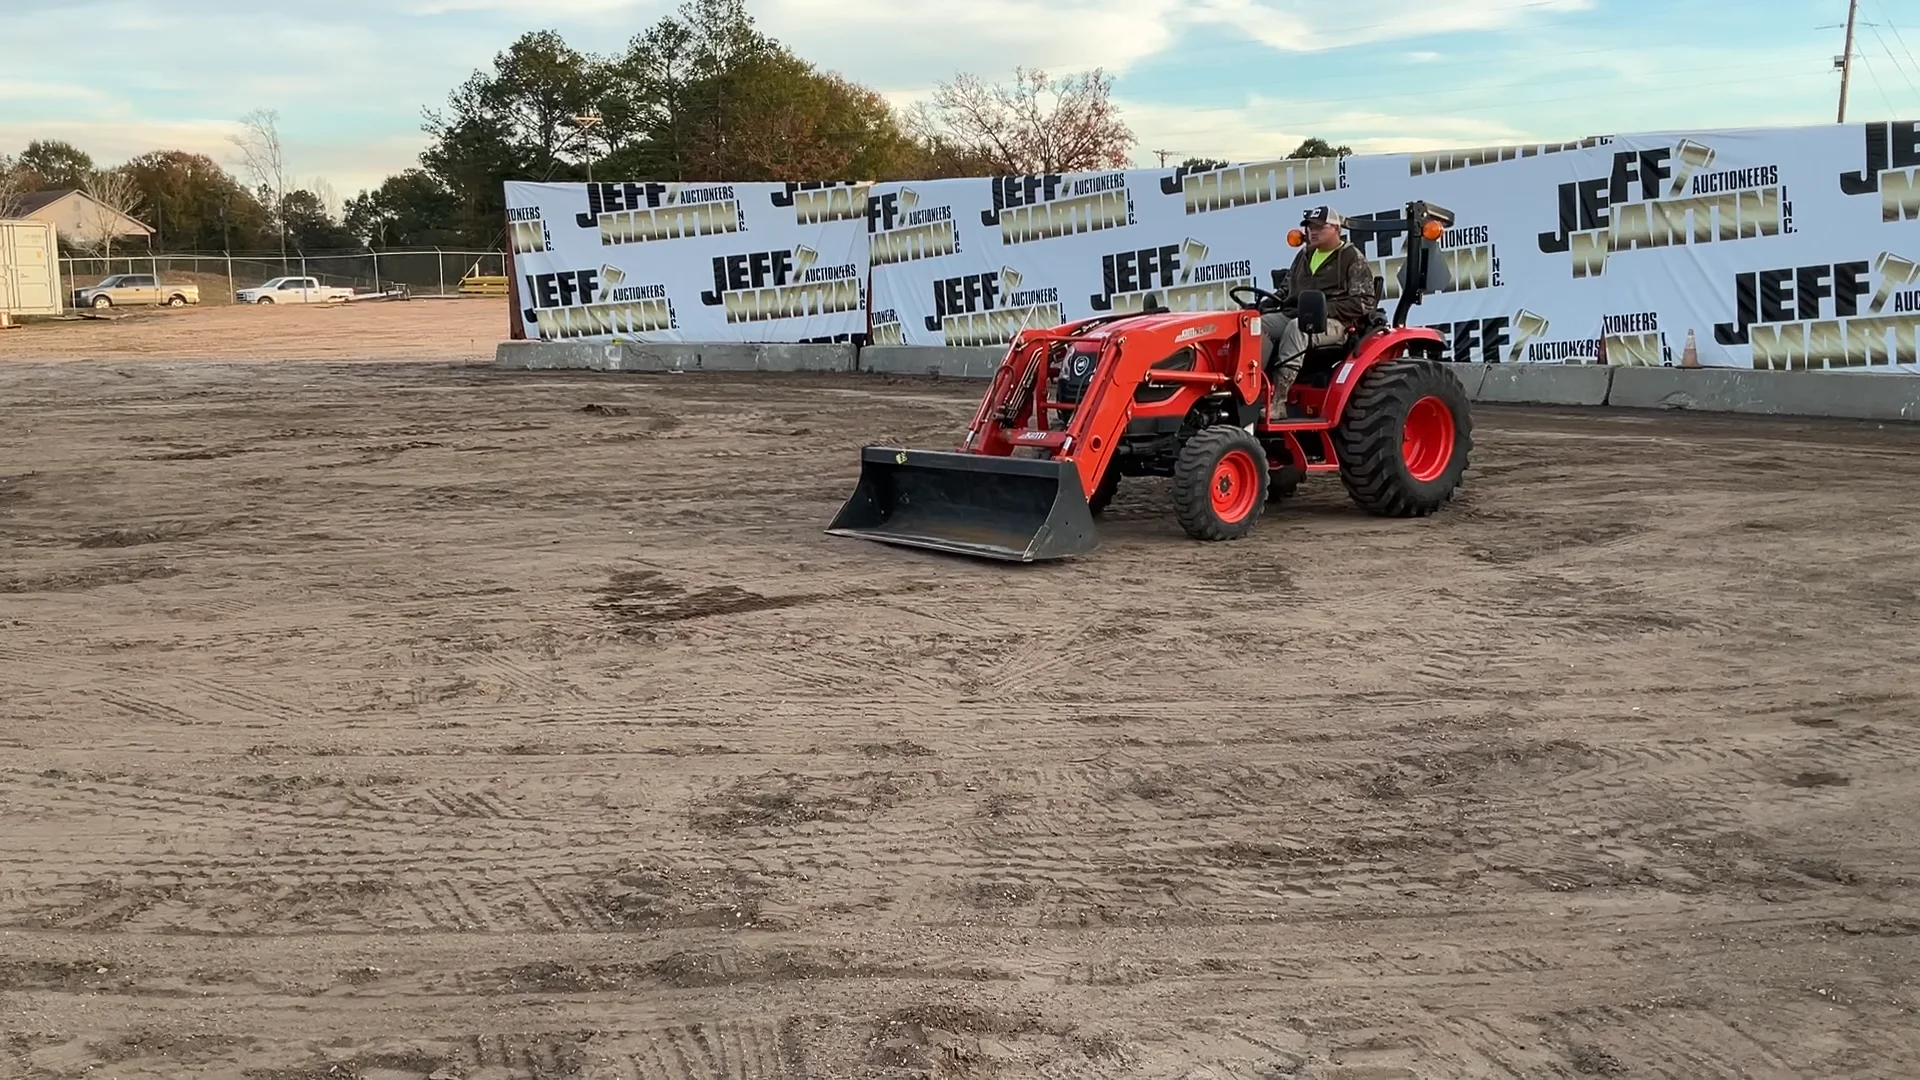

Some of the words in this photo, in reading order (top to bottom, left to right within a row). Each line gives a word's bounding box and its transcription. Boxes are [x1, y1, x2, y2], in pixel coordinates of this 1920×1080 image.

[680, 186, 734, 205] AUCTIONEERS
[981, 175, 1061, 226] JEFF
[1074, 173, 1125, 196] AUCTIONEERS
[1184, 158, 1337, 215] MARTIN
[1538, 148, 1671, 253] JEFF
[1692, 165, 1778, 195] AUCTIONEERS
[599, 201, 737, 246] MARTIN
[909, 205, 951, 226] AUCTIONEERS
[1000, 190, 1127, 245] MARTIN
[613, 284, 665, 302] AUCTIONEERS
[701, 250, 793, 306] JEFF
[805, 264, 857, 283] AUCTIONEERS
[724, 279, 857, 324] MARTIN
[925, 272, 999, 331] JEFF
[1011, 287, 1058, 307] AUCTIONEERS
[1090, 245, 1180, 311] JEFF
[1195, 260, 1250, 283] AUCTIONEERS
[1714, 261, 1870, 345] JEFF
